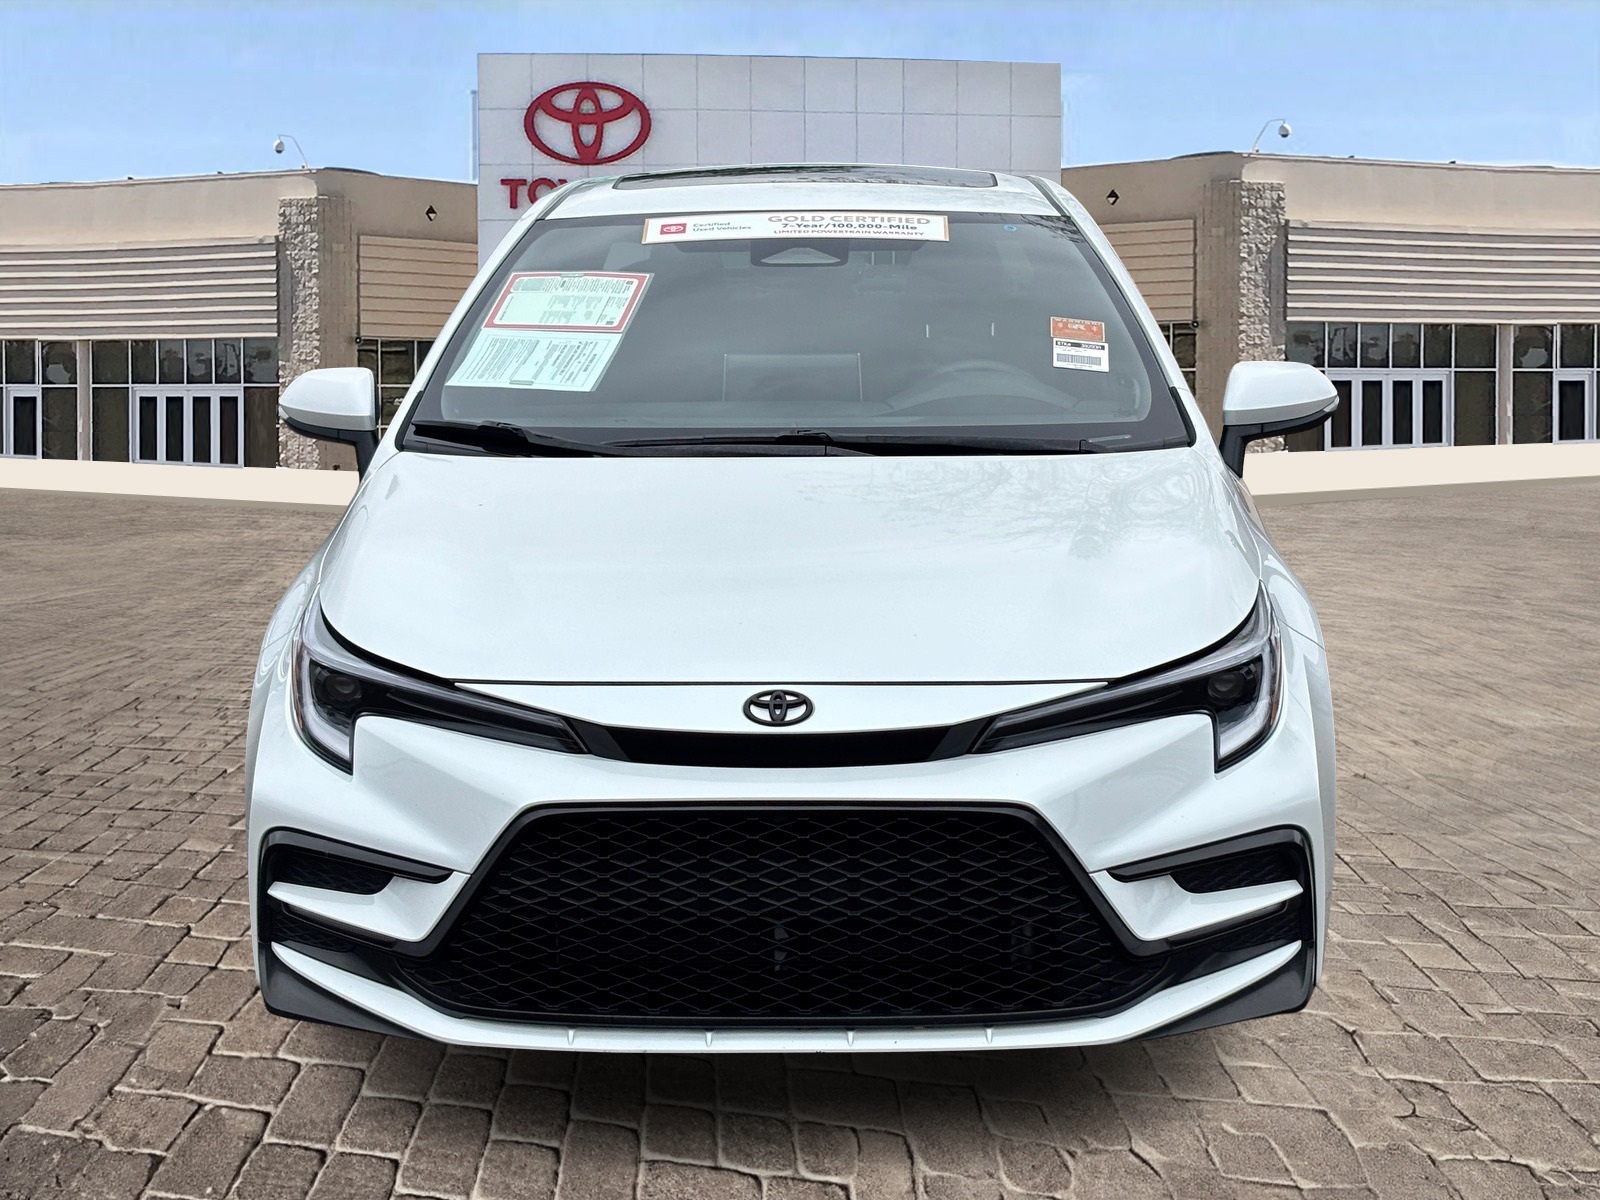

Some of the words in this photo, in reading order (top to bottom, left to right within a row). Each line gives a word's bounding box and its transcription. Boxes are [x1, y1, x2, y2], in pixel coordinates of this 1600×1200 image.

[500, 177, 568, 209] TO
[829, 215, 931, 224] CERTIFIED
[781, 222, 918, 230] 7-Year/100,000-Mile
